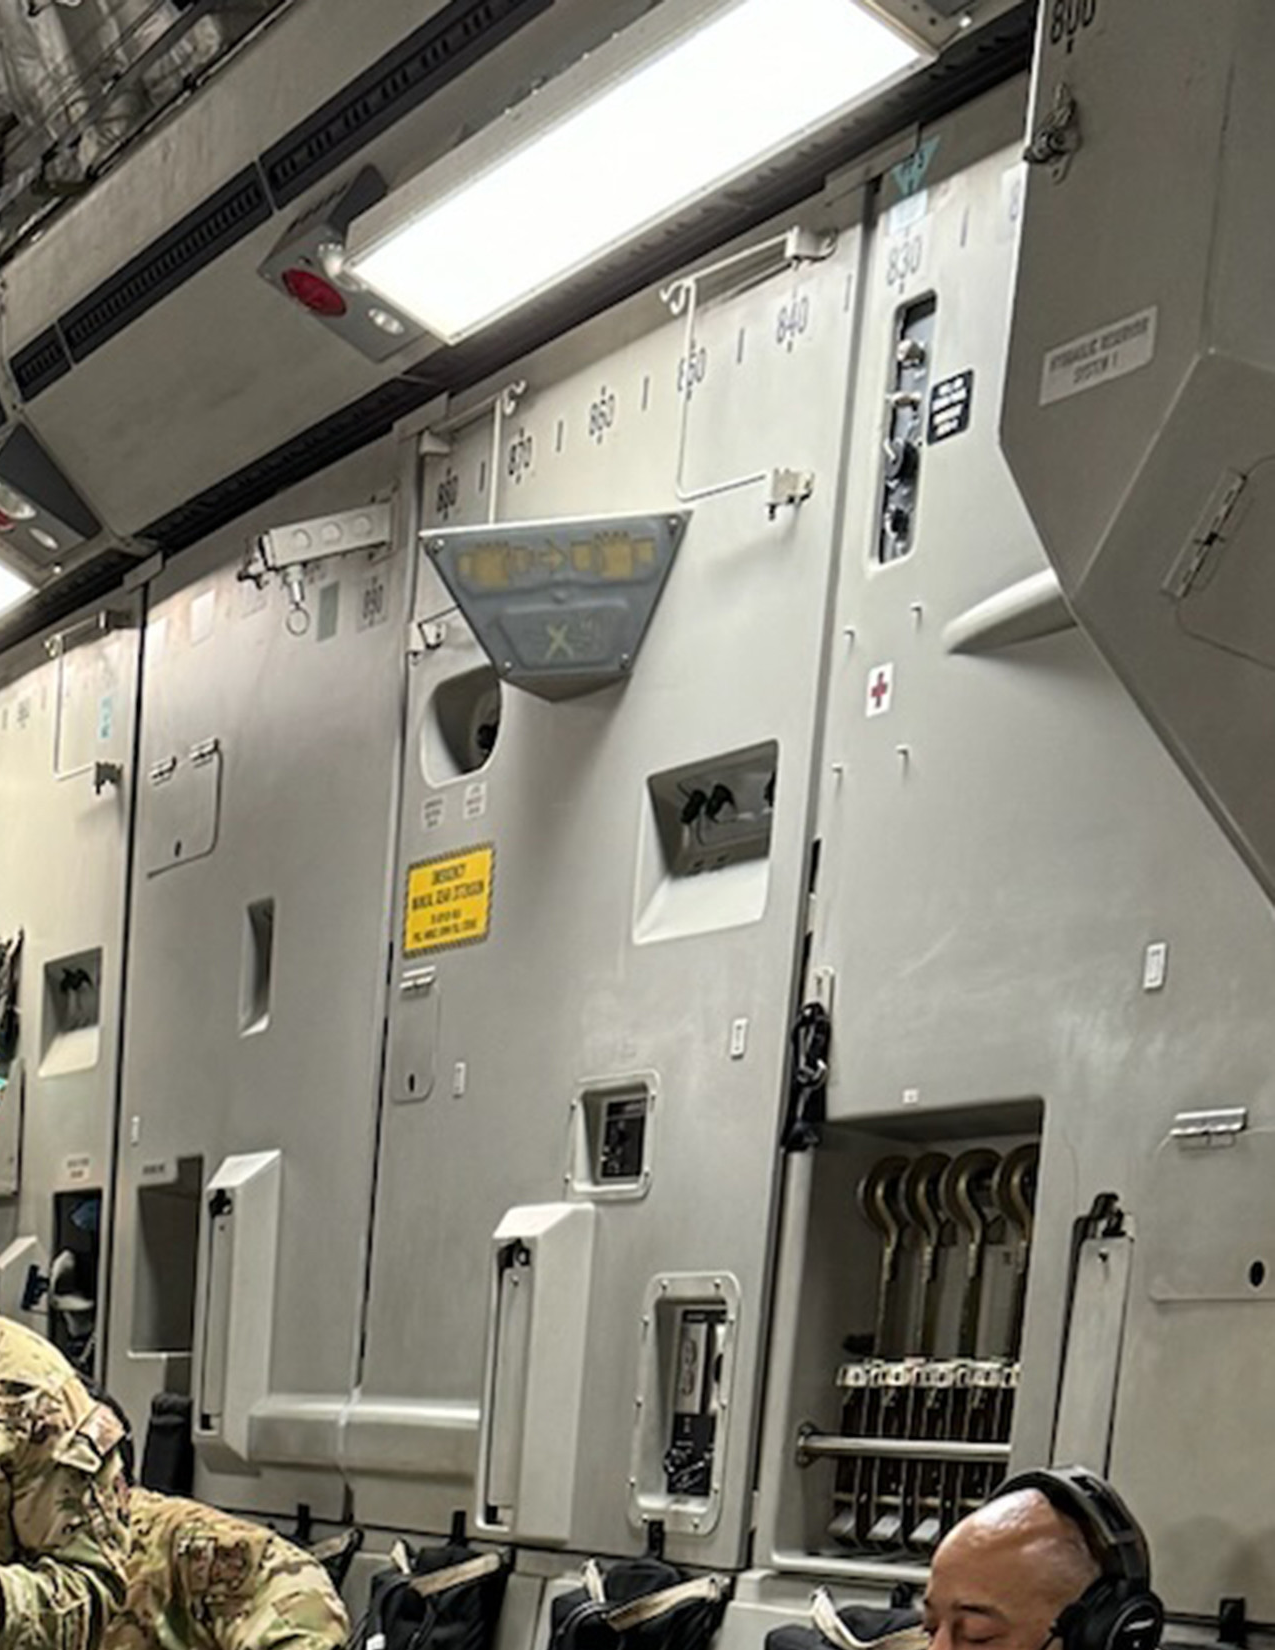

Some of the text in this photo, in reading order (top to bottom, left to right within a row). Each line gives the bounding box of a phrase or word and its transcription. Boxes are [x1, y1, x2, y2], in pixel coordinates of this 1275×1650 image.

[1051, 0, 1096, 45] 800
[886, 235, 922, 287] 830
[777, 297, 808, 343] 840
[589, 394, 615, 435] 860
[509, 435, 533, 475] 870
